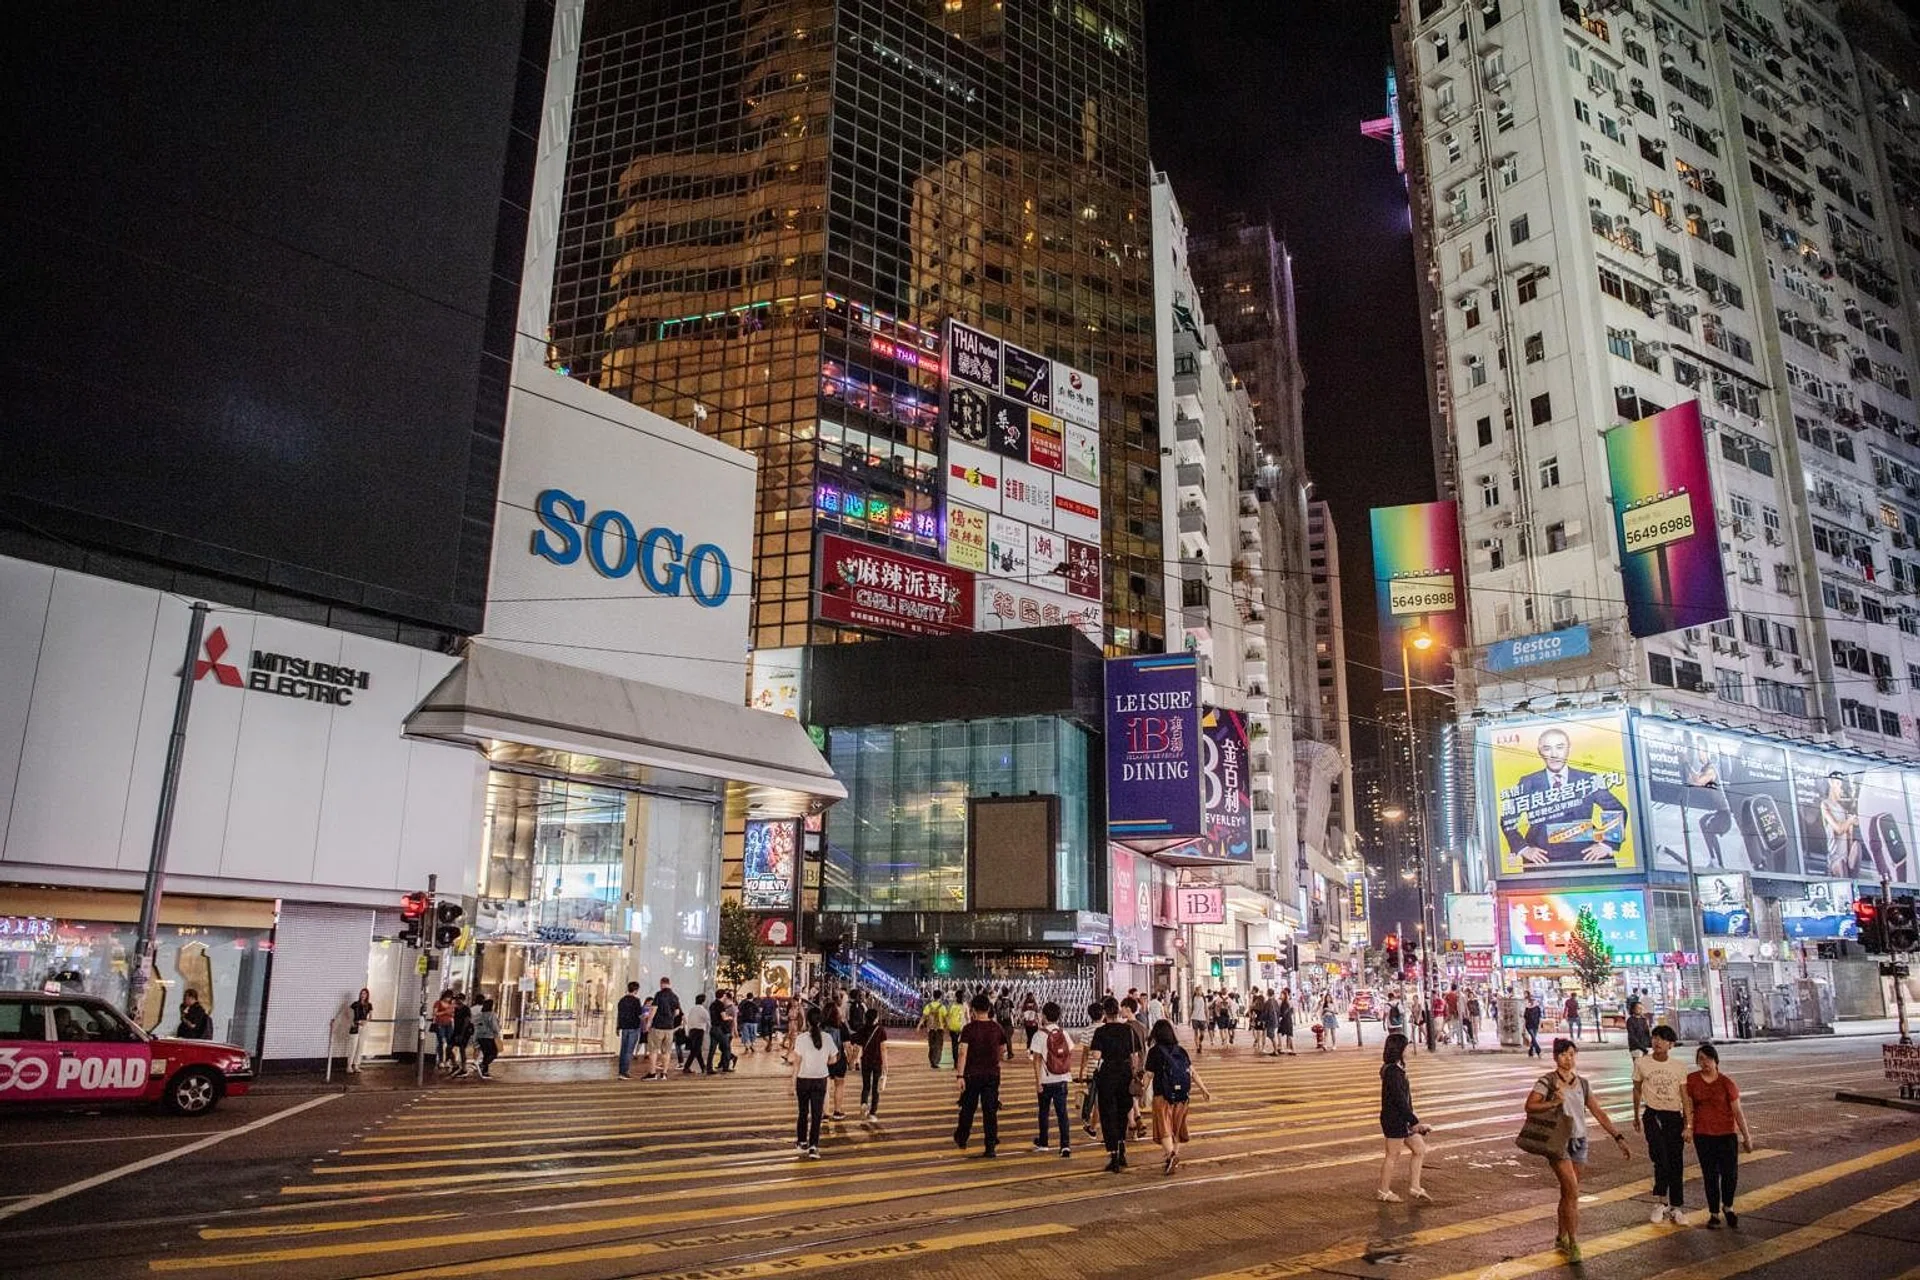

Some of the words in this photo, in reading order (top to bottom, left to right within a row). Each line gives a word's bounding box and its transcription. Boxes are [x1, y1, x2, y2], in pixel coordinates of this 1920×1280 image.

[953, 328, 978, 354] THAI
[895, 347, 917, 363] THAI
[1032, 391, 1049, 406] 8/F
[1626, 524, 1658, 544] 5649
[1660, 515, 1693, 534] 6988
[531, 488, 732, 608] SOGO
[857, 557, 948, 602] 麻辣派對
[898, 598, 946, 624] PARTY
[1392, 594, 1423, 608] 5649
[1424, 591, 1455, 605] 6988
[1512, 637, 1561, 656] Bestco
[251, 650, 370, 690] MITSUBISHI
[249, 672, 353, 708] ELECTRIC
[1116, 691, 1192, 713] LEISURE
[1123, 761, 1188, 781] DINING
[1222, 738, 1239, 813] 金百利
[1186, 894, 1210, 914] iB
[56, 1057, 147, 1090] POAD
